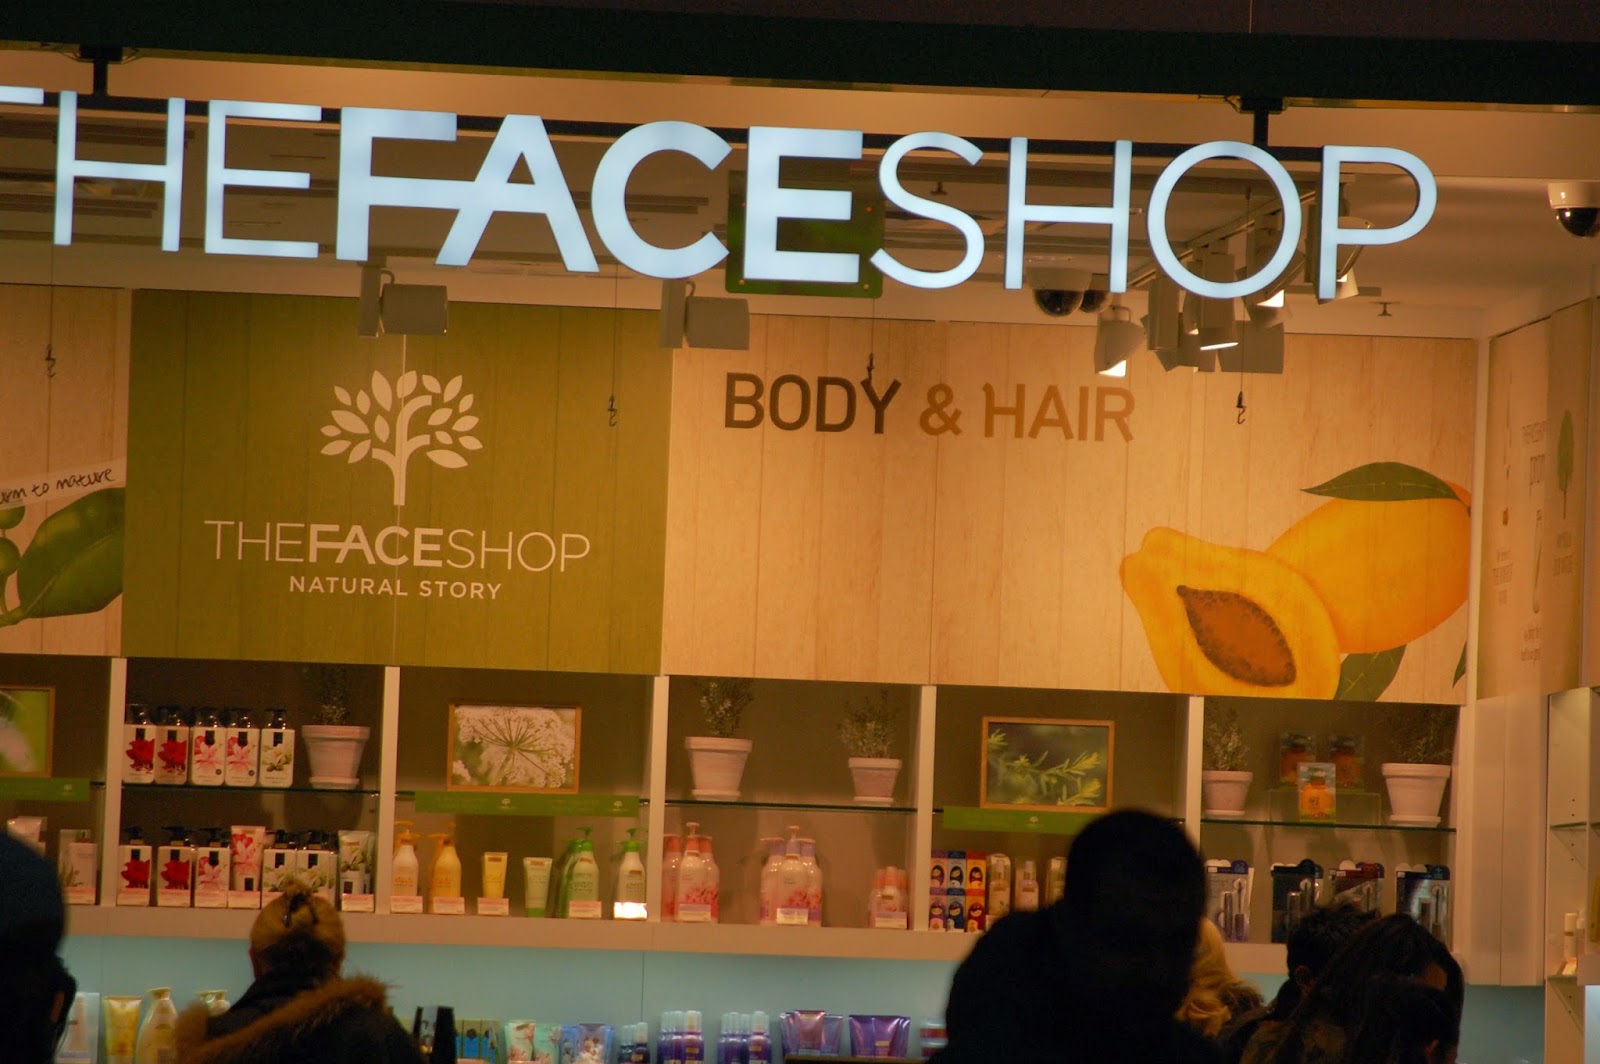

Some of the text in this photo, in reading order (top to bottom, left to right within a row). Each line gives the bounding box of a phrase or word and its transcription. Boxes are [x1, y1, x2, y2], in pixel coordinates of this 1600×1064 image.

[0, 86, 1438, 300] HEFACESHOP
[725, 371, 1136, 442] BODY & HAIR
[31, 483, 50, 497] to
[56, 468, 116, 490] nature
[289, 575, 502, 600] NATURAL STORY
